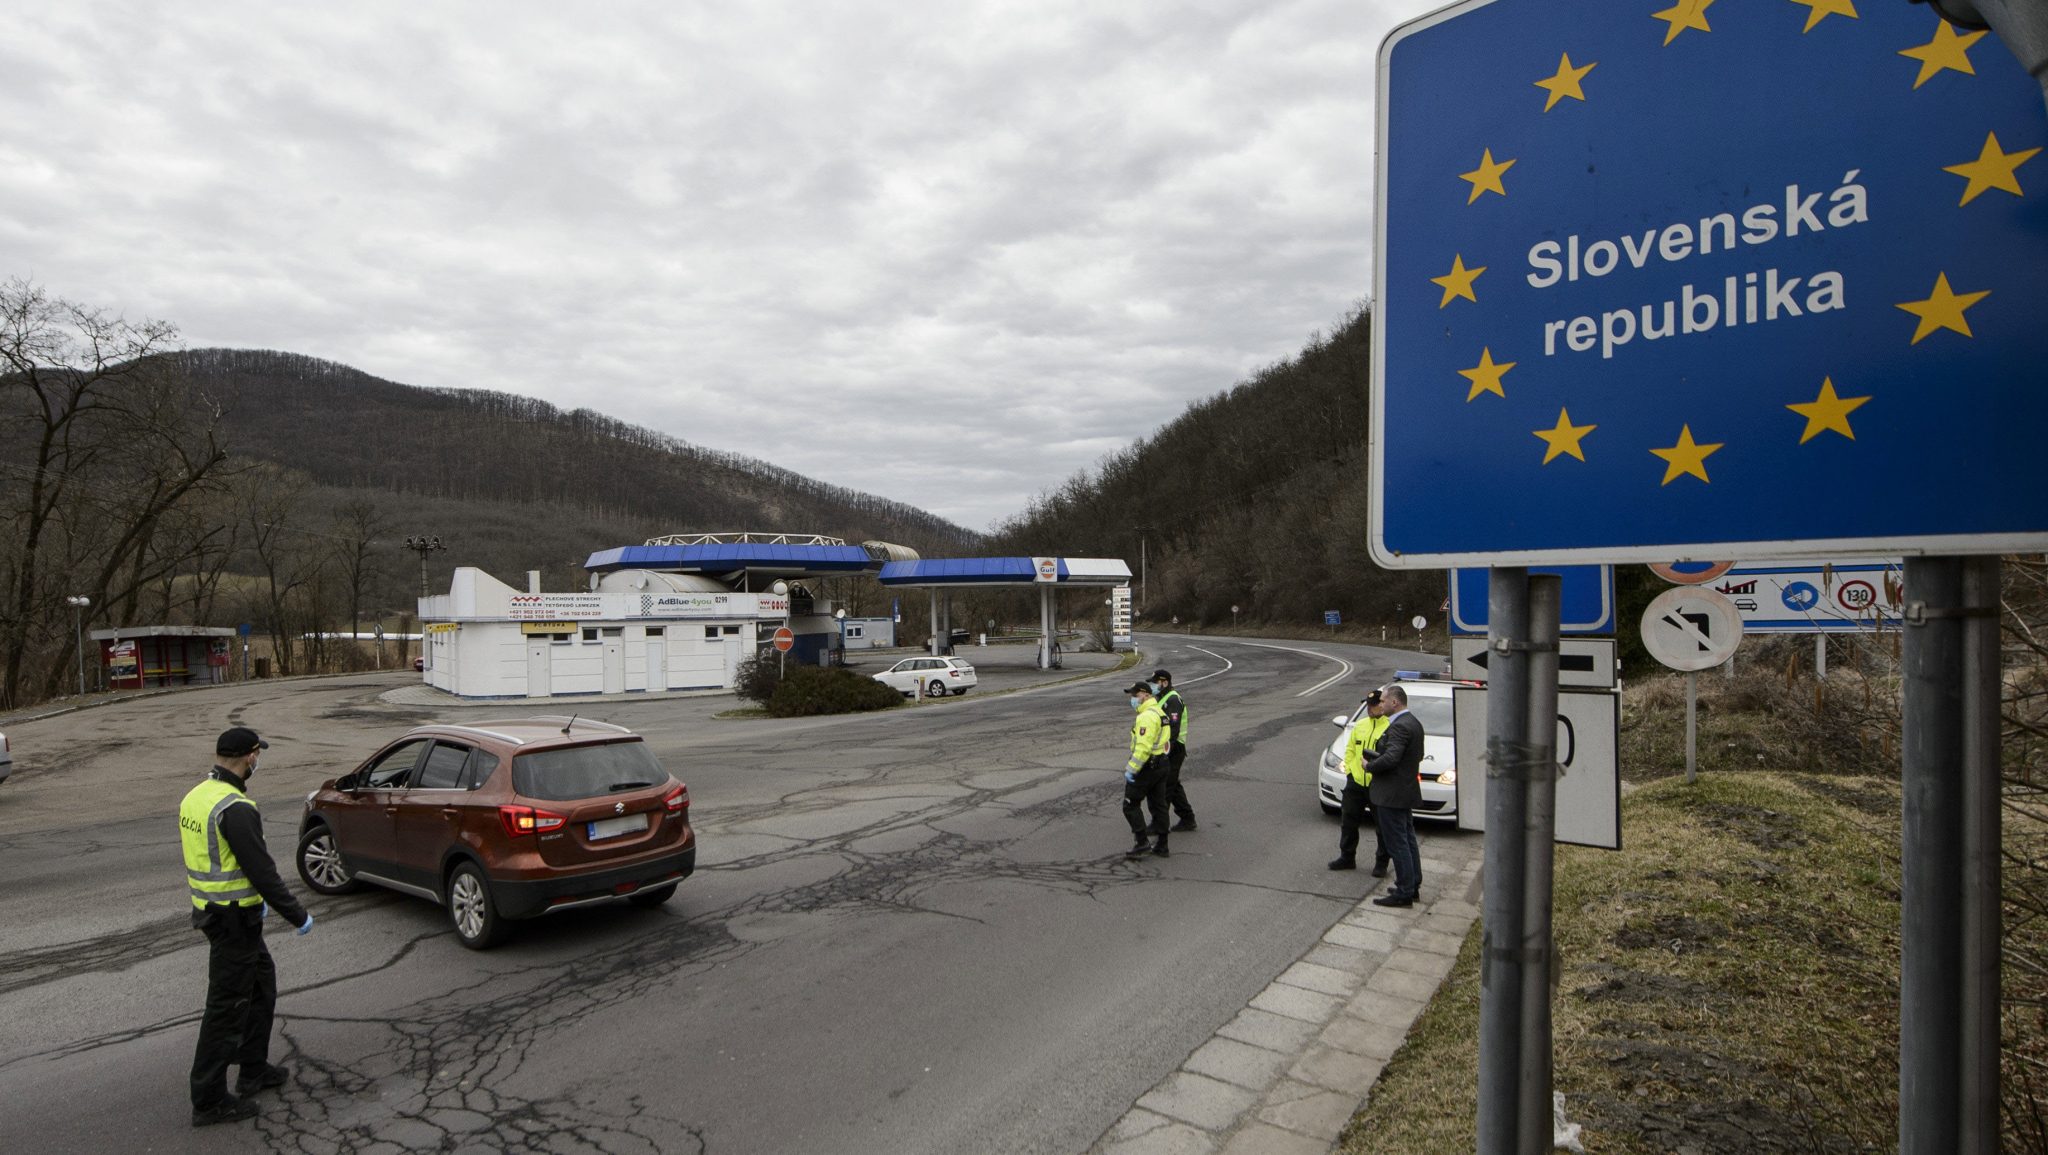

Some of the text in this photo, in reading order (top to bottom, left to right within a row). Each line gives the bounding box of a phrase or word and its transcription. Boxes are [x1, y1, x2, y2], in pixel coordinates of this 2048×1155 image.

[1526, 168, 1869, 288] Slovenská
[1544, 268, 1846, 359] republika
[690, 598, 712, 607] 4you
[1846, 589, 1868, 601] 130
[180, 816, 202, 834] OLÍCIA
